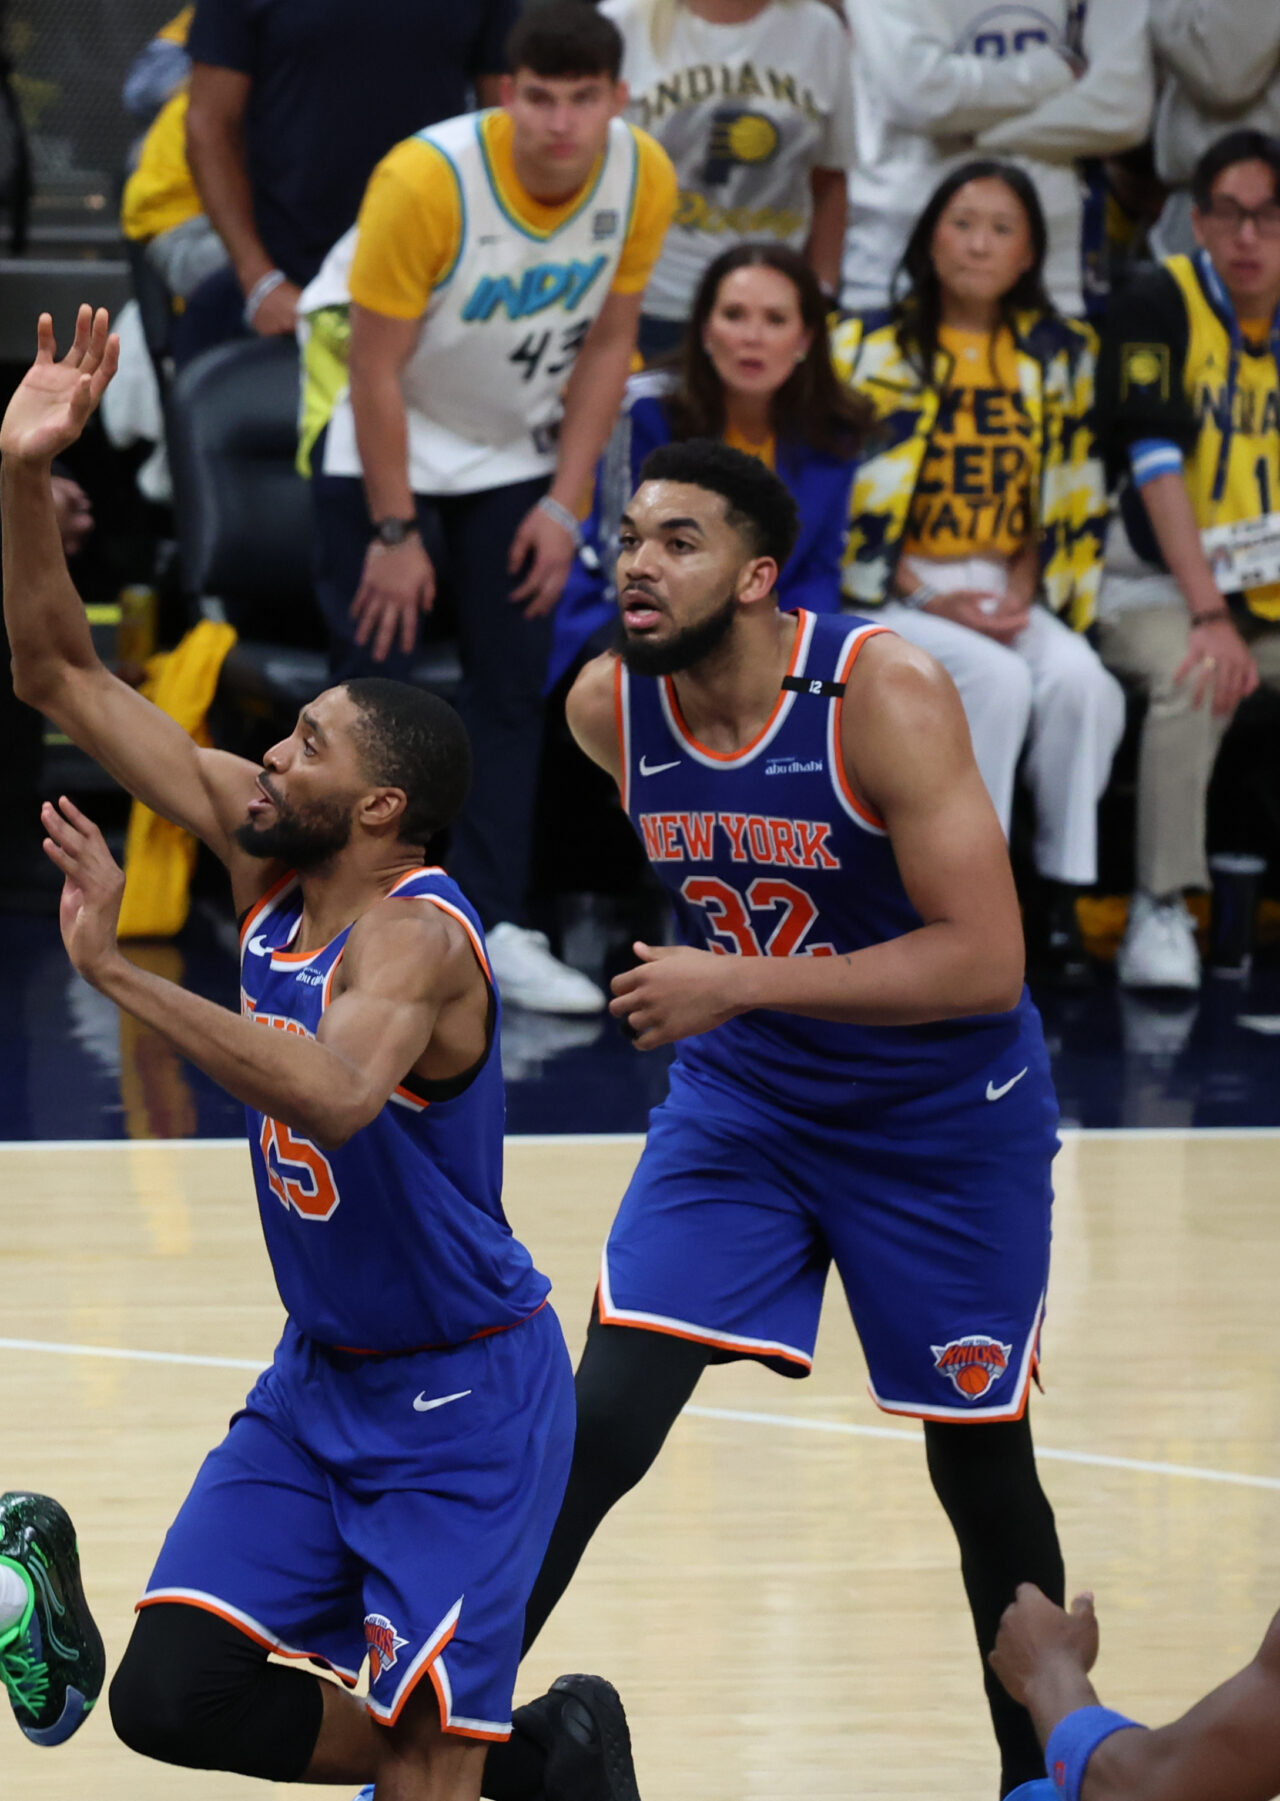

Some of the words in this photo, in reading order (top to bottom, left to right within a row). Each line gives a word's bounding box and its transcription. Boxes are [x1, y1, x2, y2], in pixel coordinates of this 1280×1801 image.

[460, 254, 608, 322] INDY
[809, 680, 823, 694] 12
[788, 760, 823, 773] dhabi
[639, 813, 716, 862] NEW
[719, 812, 841, 869] YORK
[680, 876, 837, 957] 32
[938, 1344, 1007, 1368] KNICKS
